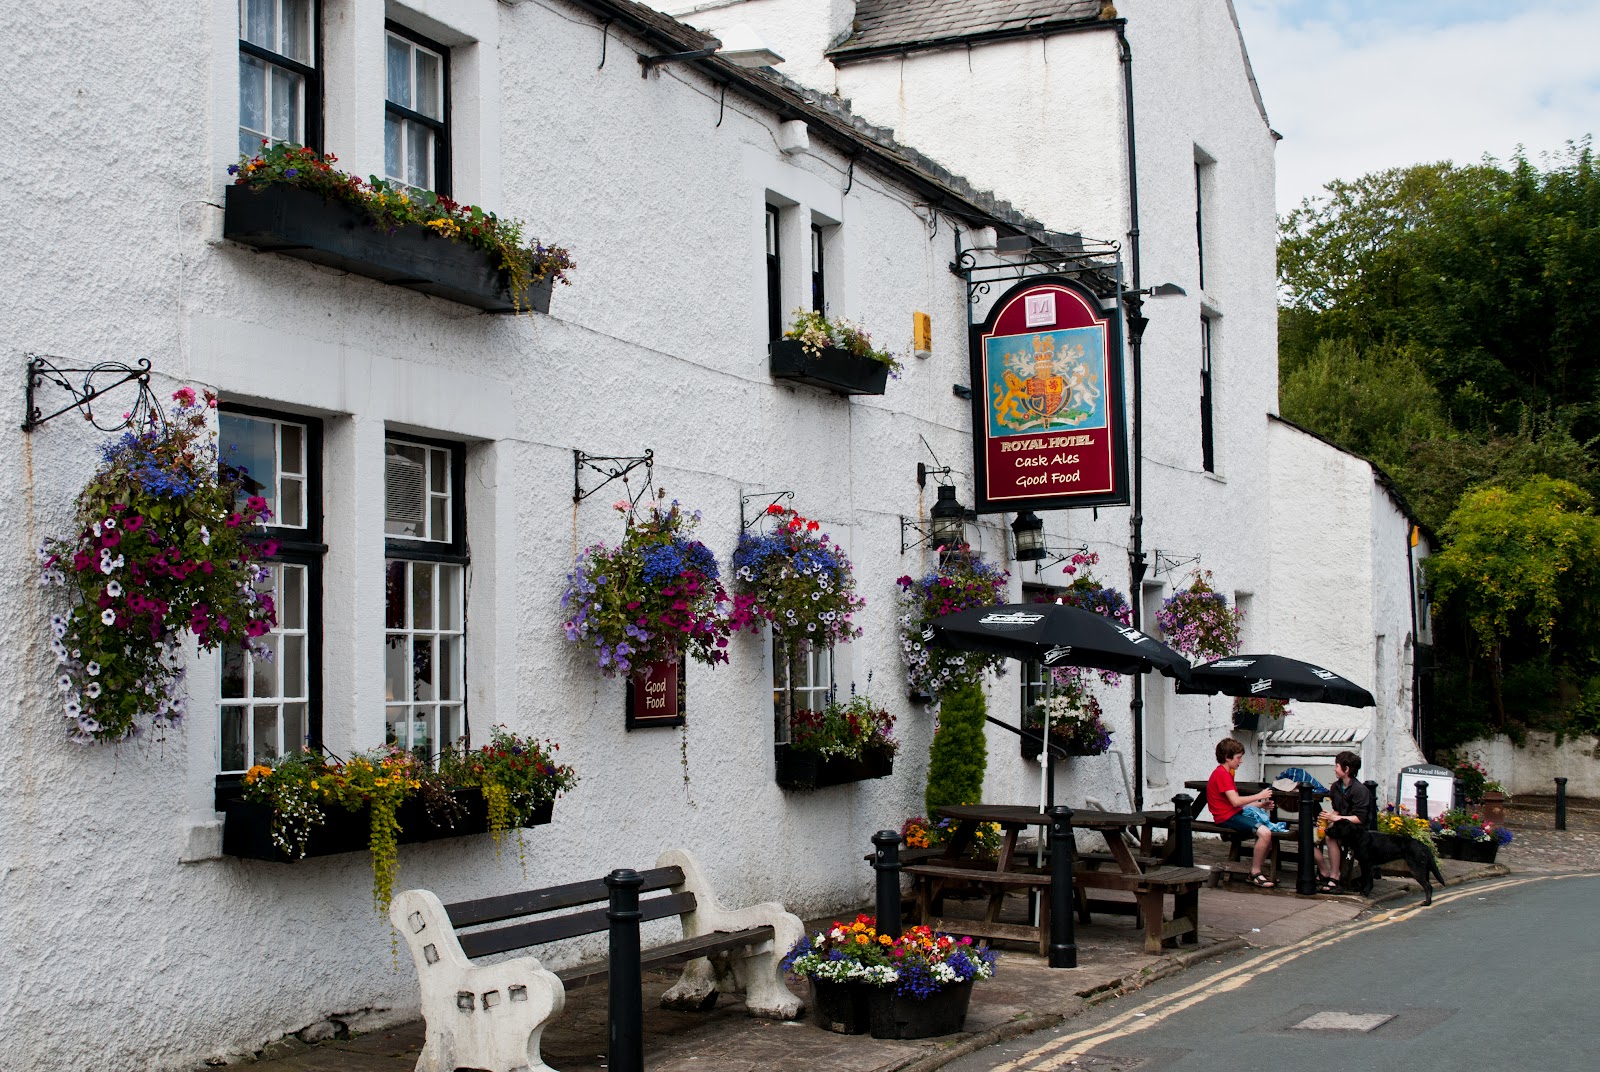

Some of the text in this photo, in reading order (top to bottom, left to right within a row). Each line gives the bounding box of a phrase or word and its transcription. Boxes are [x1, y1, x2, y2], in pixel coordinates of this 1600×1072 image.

[1032, 299, 1050, 315] M
[1000, 435, 1095, 452] ROYAL HOTEL
[1015, 453, 1080, 468] Cask Ales
[1016, 470, 1080, 488] Good Food
[645, 677, 667, 695] Good
[646, 693, 665, 709] Food
